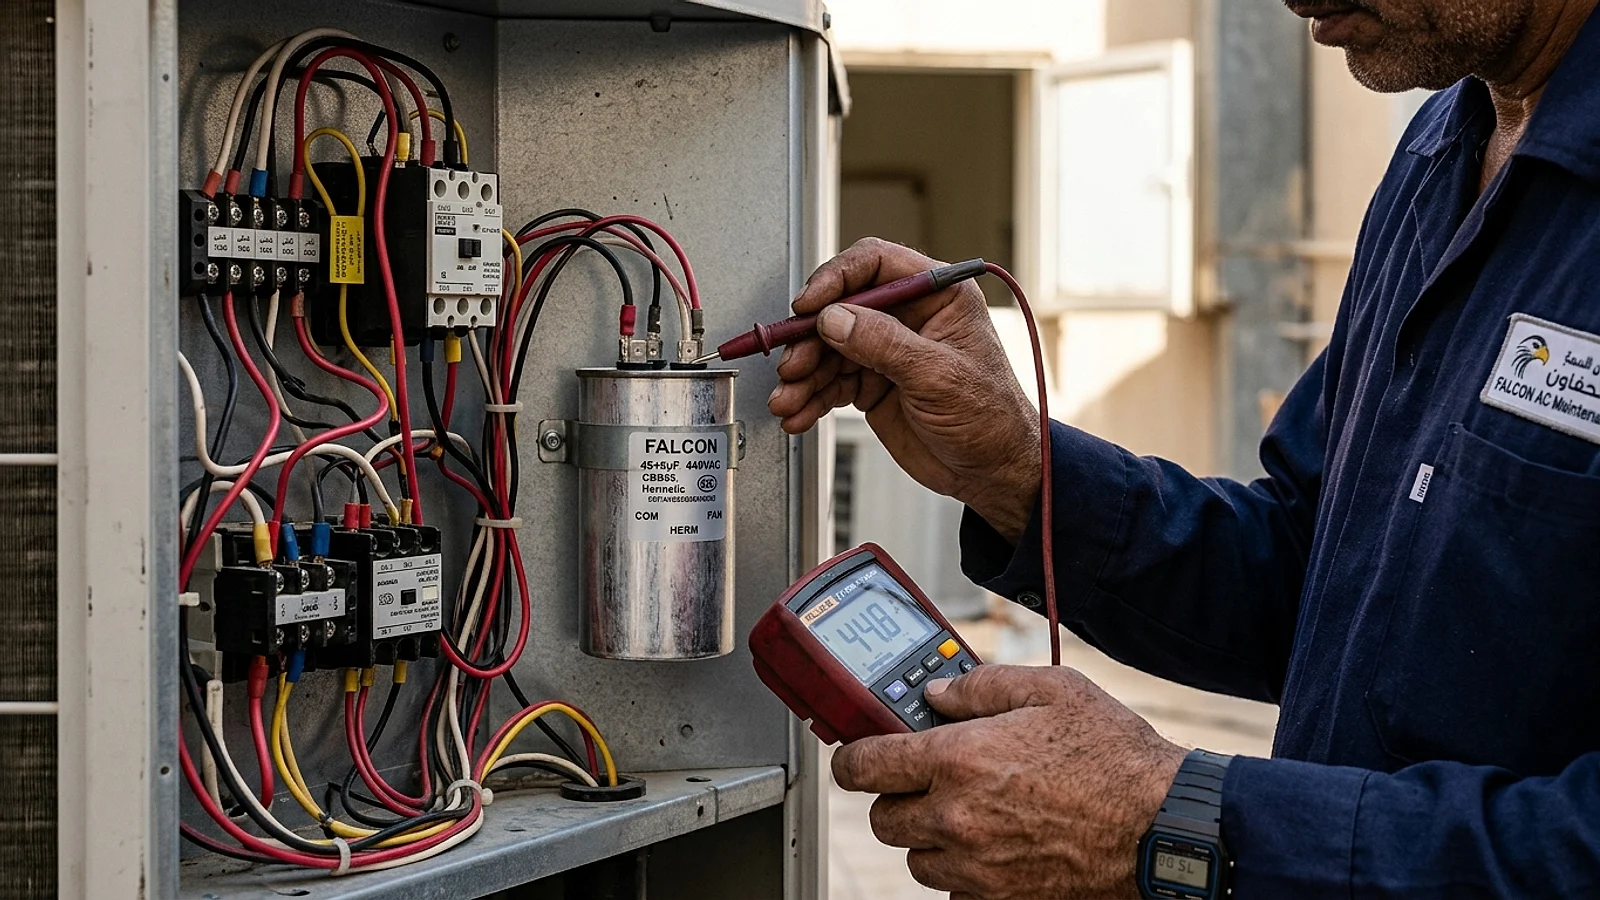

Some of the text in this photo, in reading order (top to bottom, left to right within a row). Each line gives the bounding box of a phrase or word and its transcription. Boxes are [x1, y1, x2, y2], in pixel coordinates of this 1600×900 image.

[1494, 376, 1535, 402] FALCON
[1535, 390, 1552, 407] AC
[645, 439, 718, 454] FALCON
[635, 511, 659, 520] COM
[670, 526, 699, 535] HERM
